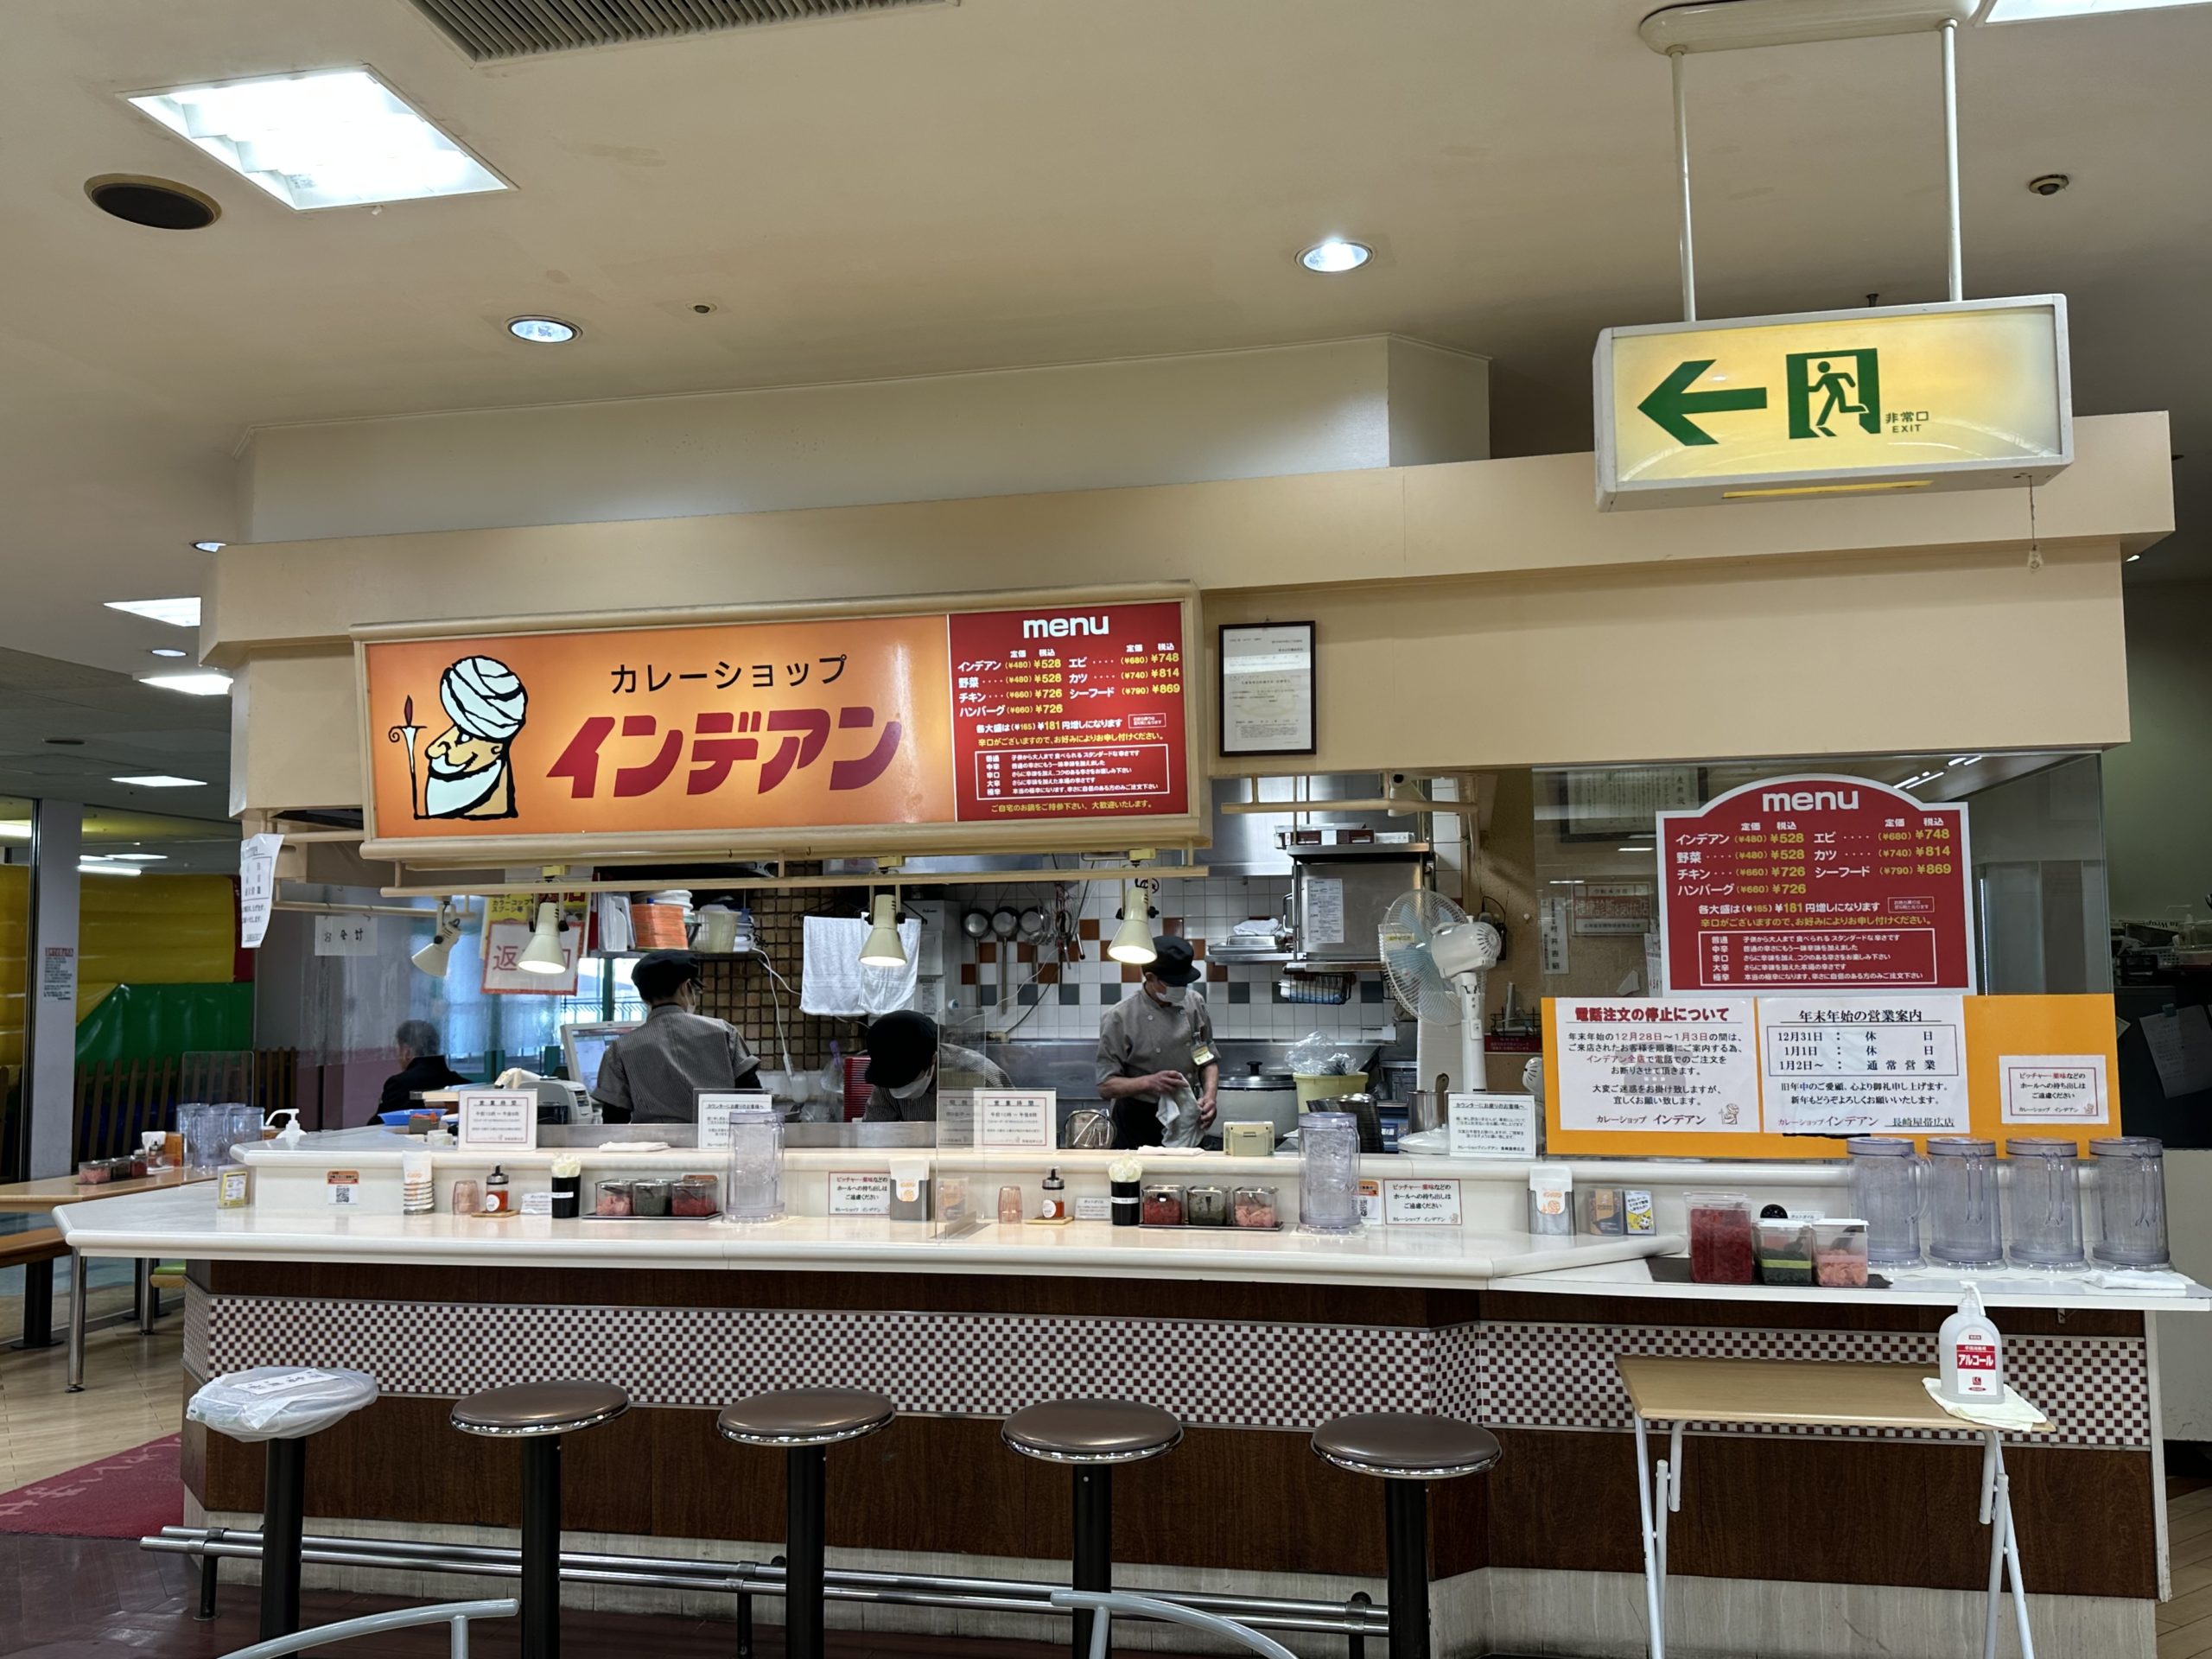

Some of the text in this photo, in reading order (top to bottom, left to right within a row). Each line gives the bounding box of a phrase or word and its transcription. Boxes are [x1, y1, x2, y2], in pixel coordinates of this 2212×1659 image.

[1884, 410, 1929, 423] 非常口
[1892, 423, 1922, 433] EXIT
[1023, 615, 1109, 639] menu
[957, 660, 1001, 672] インデアン
[1033, 658, 1061, 669] ¥528
[1068, 657, 1087, 668] エビ
[1151, 652, 1179, 663] ¥748
[610, 653, 847, 695] カレーショップ
[958, 677, 979, 688] 野菜
[1033, 674, 1062, 683] ¥528
[1069, 673, 1088, 684] カツ
[1151, 668, 1179, 678] ¥814
[958, 692, 987, 703] チキン
[1034, 689, 1063, 699] ¥726
[1070, 686, 1115, 700] シーフード
[1152, 683, 1180, 694] ¥869
[959, 705, 1006, 717] ハンバーグ
[1035, 703, 1064, 714] ¥726
[546, 707, 902, 799] インデアン
[1762, 791, 1859, 812] menu
[1740, 817, 1944, 831] 定価 税込 定価 税込
[1675, 833, 1730, 846] インデアン
[1770, 833, 1804, 843] ¥528
[1813, 831, 1837, 843] エビ
[1915, 828, 1950, 840] ¥748
[1676, 851, 1702, 864] 野菜
[1770, 849, 1805, 860] ¥528
[1814, 850, 1837, 861] カツ
[1916, 845, 1951, 857] ¥814
[1676, 868, 1711, 880] チキン
[1771, 866, 1806, 877] ¥726
[1815, 866, 1870, 879] シーフード
[1916, 863, 1952, 874] ¥869
[1677, 883, 1735, 897] ハンバーグ
[1772, 883, 1807, 894] ¥726
[1700, 916, 1931, 928] 辛口がございますので、お好みによりお申し付けください。
[1574, 1007, 1729, 1022] 電話注文の停止について
[1798, 1009, 1923, 1023] 年末年始の営業案内
[1777, 1032, 1823, 1042] 12月31日
[1568, 1044, 1743, 1053] ご来店されたお客様を順番にご案内する為、
[1784, 1046, 1818, 1057] 1月1日
[1586, 1055, 1726, 1065] インデアン全店で電話でのご注文を
[1611, 1066, 1701, 1076] お断りさせて頂きます。
[1592, 1084, 1721, 1095] 大変ご迷惑をお掛け致しますが、
[1781, 1082, 1948, 1092] 旧年中のご愛顧、心より御礼申し上げます。
[1613, 1096, 1701, 1106] 宜しくお願い致します。
[1790, 1096, 1941, 1105] 新年もどうぞよろしくお願いいたします。
[1596, 1115, 1707, 1126] カレーショップ インデアン
[1892, 1117, 1955, 1128] 長崎屋帯広店
[1958, 1353, 1994, 1367] アルコール
